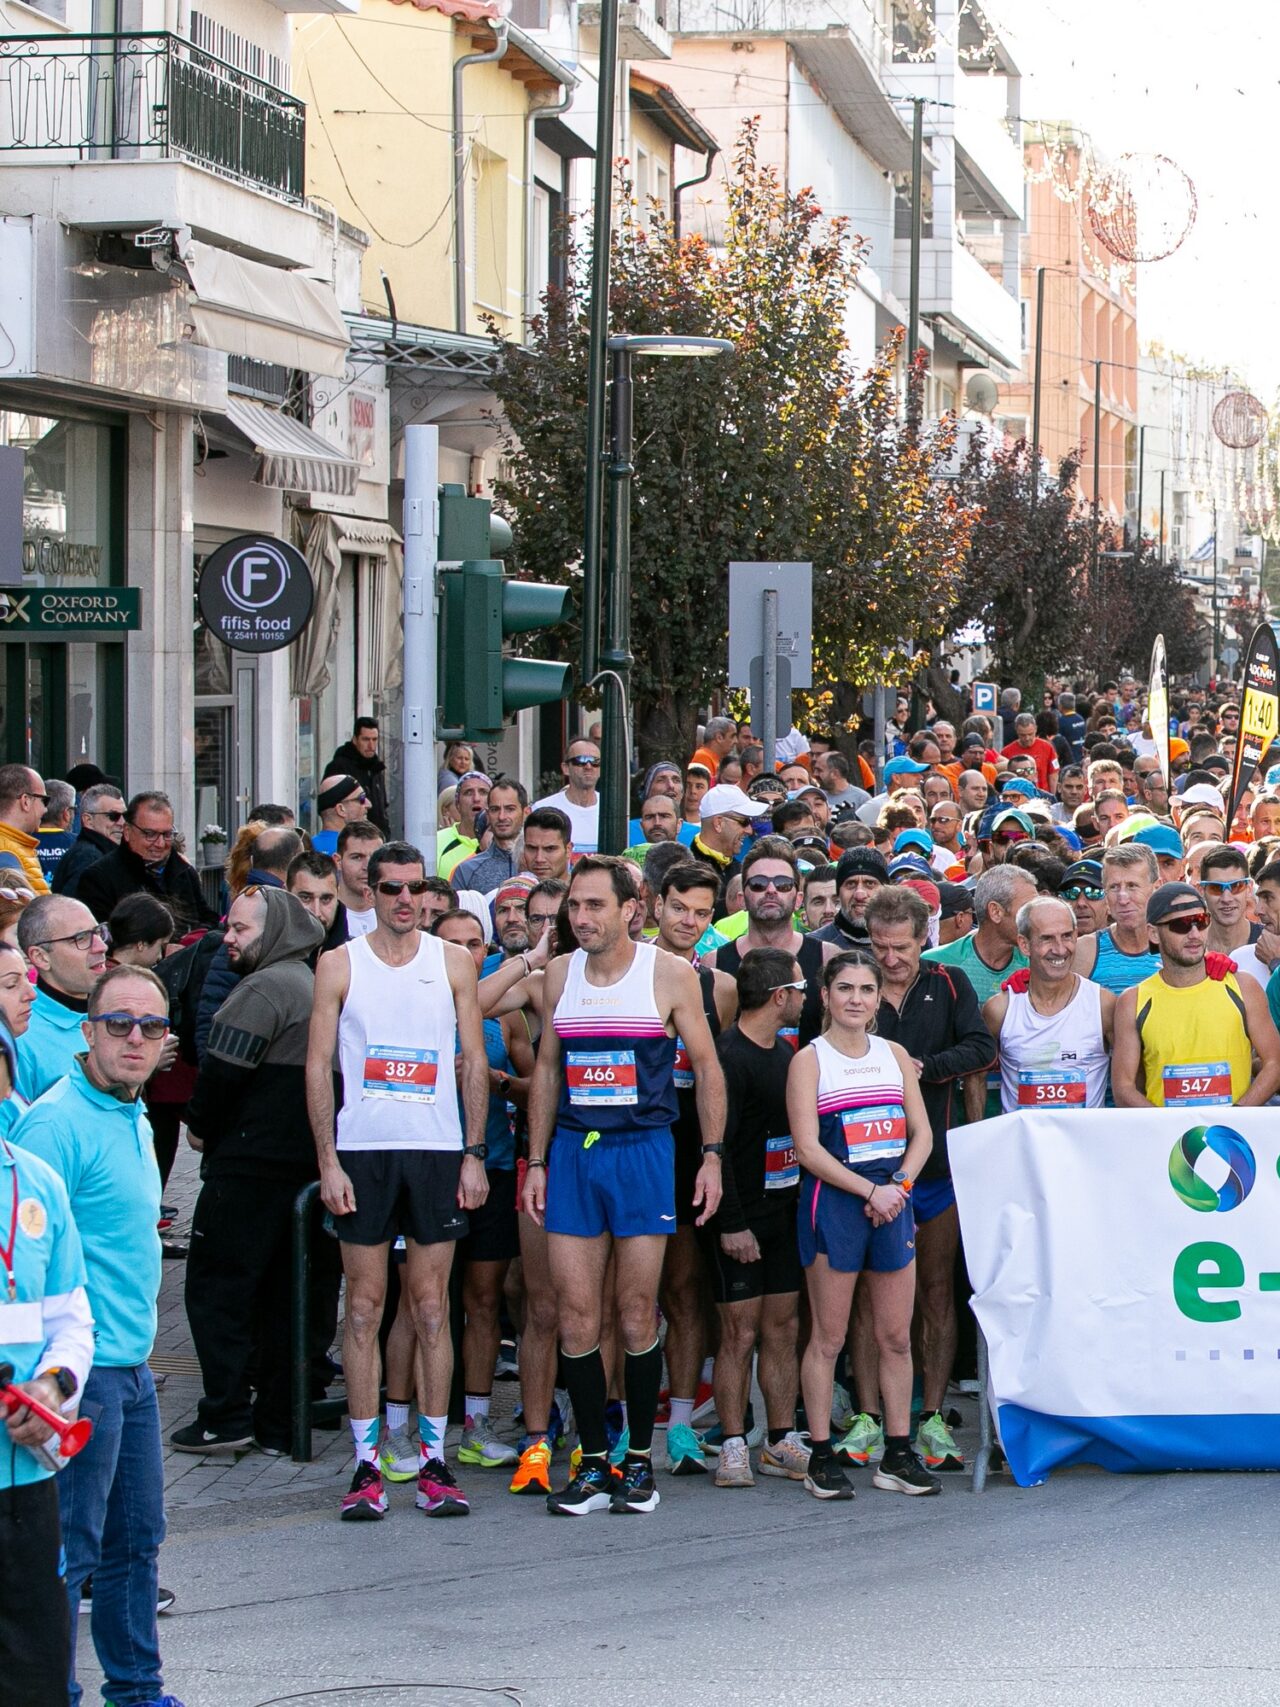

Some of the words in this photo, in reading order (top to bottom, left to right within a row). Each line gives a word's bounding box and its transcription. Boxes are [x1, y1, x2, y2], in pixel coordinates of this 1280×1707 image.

[41, 595, 118, 608] OXFORD
[41, 609, 131, 623] COMPANY
[221, 616, 250, 629] fifis
[255, 616, 290, 630] food
[261, 632, 285, 640] 10155
[977, 688, 993, 707] P
[1247, 695, 1273, 730] 1:40
[385, 1061, 419, 1077] 387
[583, 1068, 615, 1082] 466
[844, 1066, 881, 1075] saucony
[1036, 1085, 1067, 1100] 536
[1180, 1078, 1212, 1093] 547
[863, 1120, 894, 1137] 719
